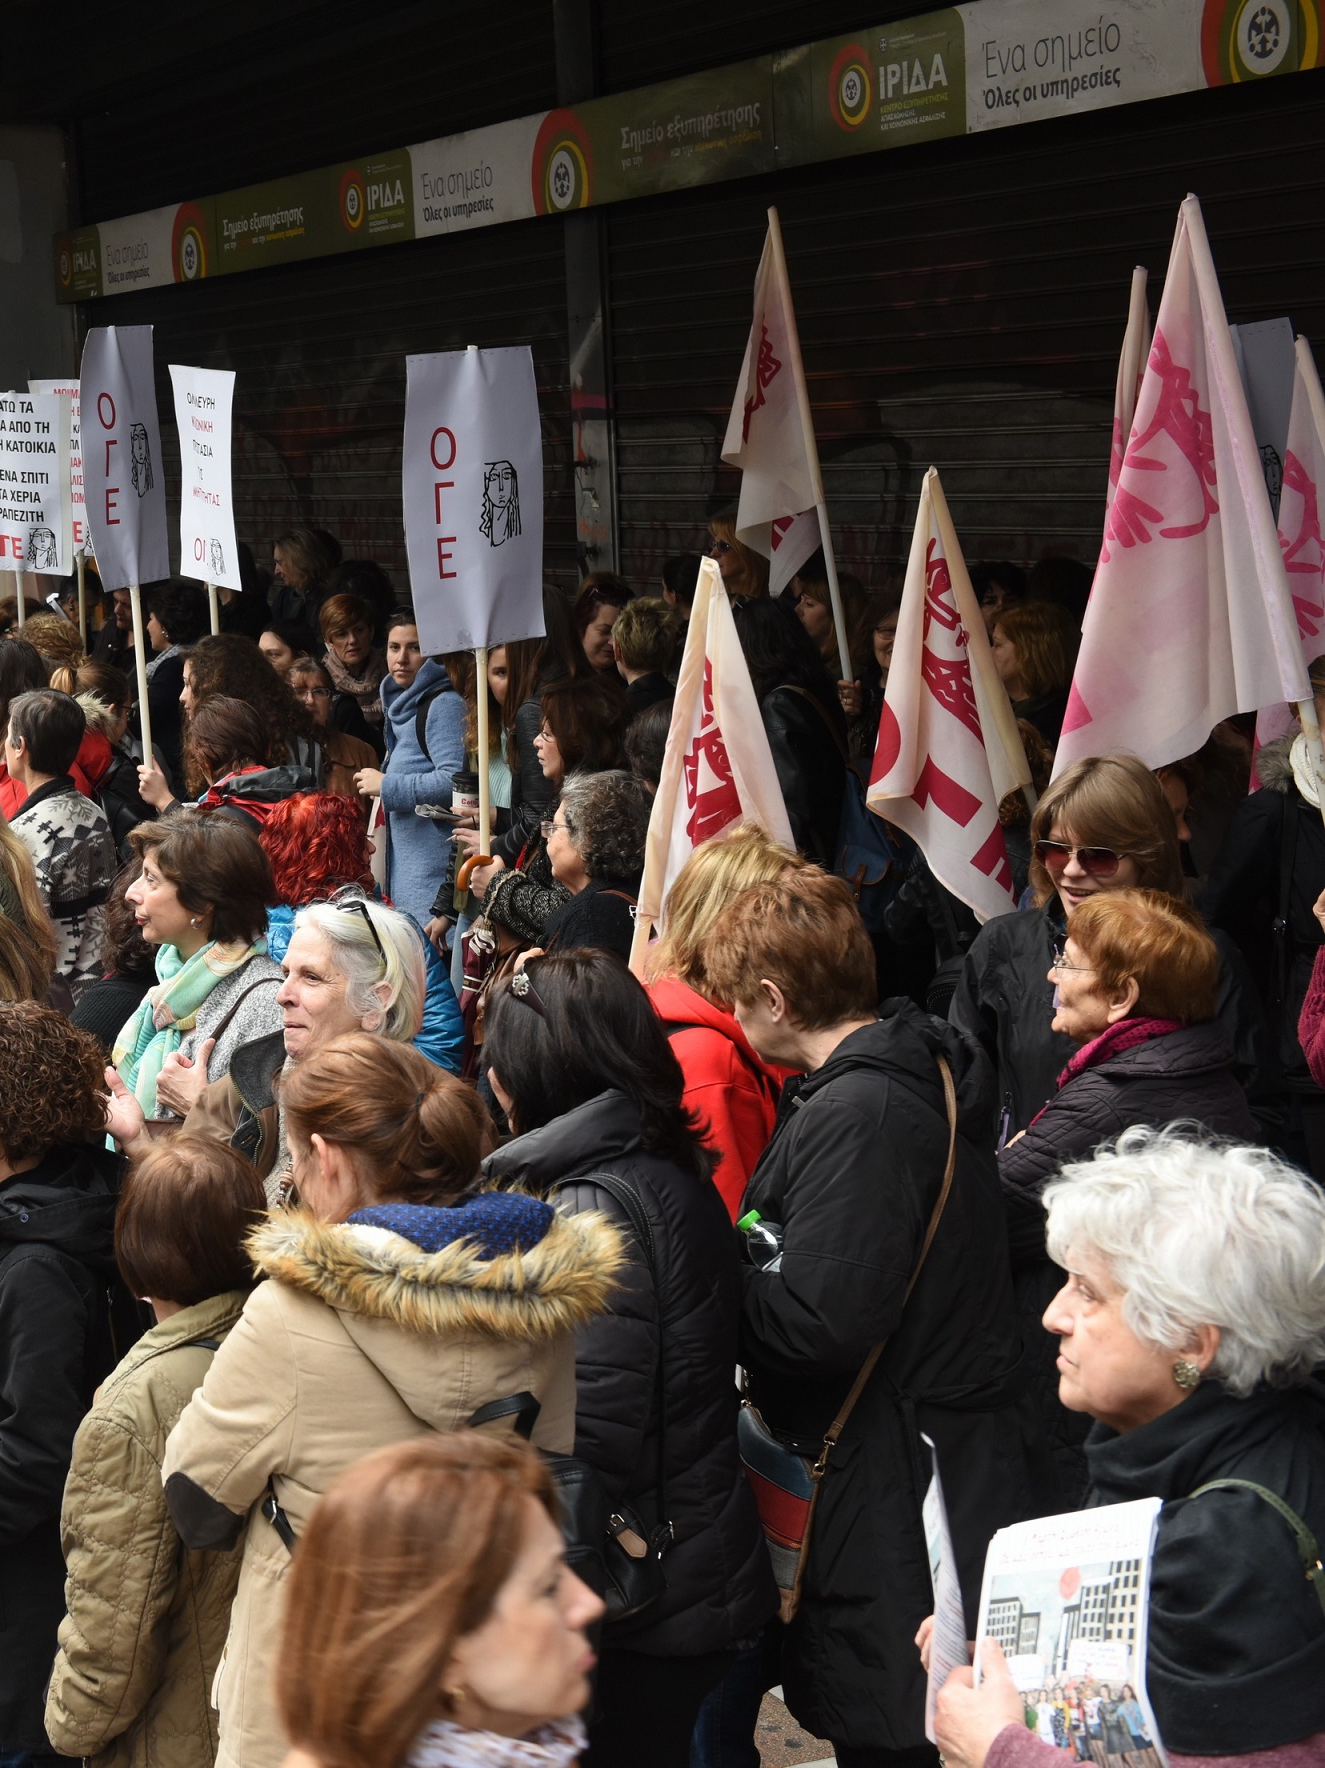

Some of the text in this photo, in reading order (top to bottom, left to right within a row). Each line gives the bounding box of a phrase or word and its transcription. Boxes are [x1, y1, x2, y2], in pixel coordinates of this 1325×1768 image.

[982, 15, 1120, 78] Ένα σημείο
[879, 53, 948, 100] ΙΡΙΔΑ
[982, 65, 1121, 109] Όλες οι υπηρεσίες
[620, 102, 761, 152] Σημείο εξυπηρέτησης
[366, 179, 405, 211] ΙΡΙΔΑ
[447, 160, 493, 199] σημείο
[222, 216, 249, 239] Σημείο
[249, 207, 304, 233] εξυπηρέτησης
[423, 206, 443, 222] Όλες
[443, 206, 452, 218] οι
[452, 195, 494, 219] υπηρεσίες
[19, 401, 34, 413] ΤΑ
[8, 419, 31, 433] ΑΠΟ
[34, 421, 50, 434] ΤΗ
[5, 439, 57, 454] ΚΑΤΟΙΚΙΑ
[97, 392, 121, 526] ΟΓΕ
[20, 471, 49, 485] ΣΠΙΤΙ
[10, 489, 42, 503] ΧΕΡΙΑ
[429, 426, 458, 579] ΟΓΕ
